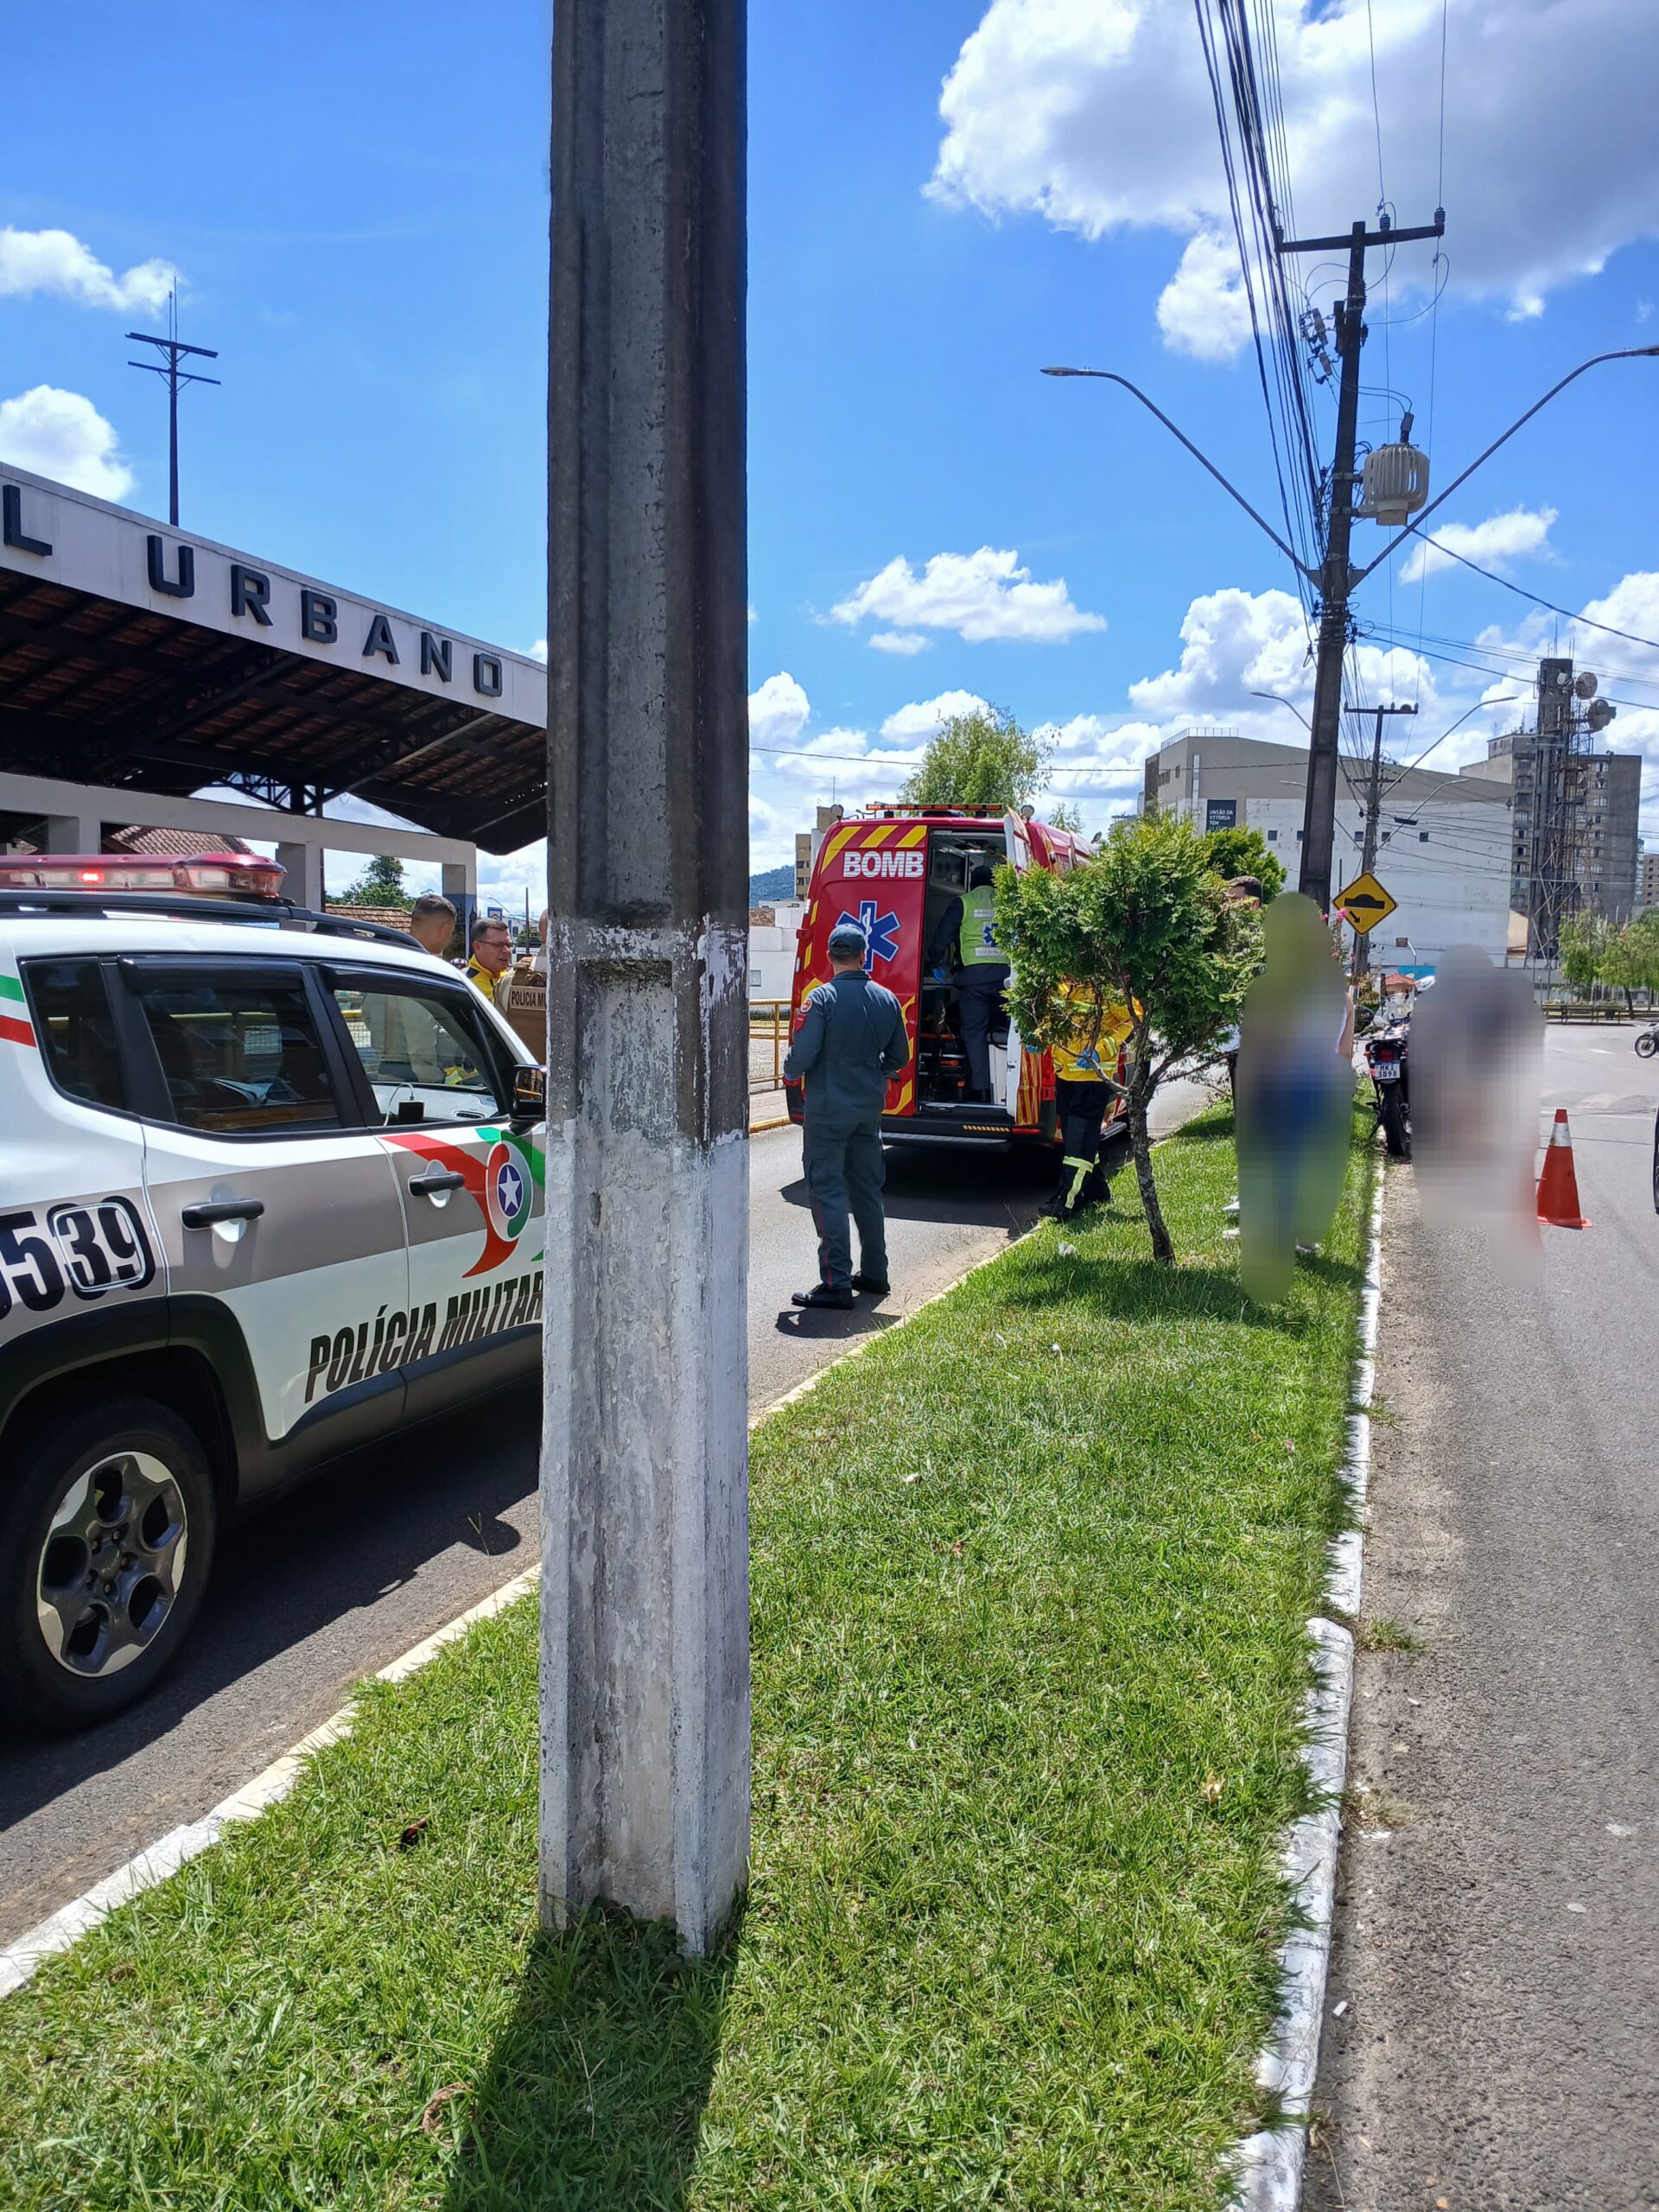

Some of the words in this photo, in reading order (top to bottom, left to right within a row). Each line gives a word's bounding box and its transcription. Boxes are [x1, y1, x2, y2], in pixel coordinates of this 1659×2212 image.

[147, 534, 503, 697] URBANO
[843, 850, 924, 878] BOMB
[0, 1196, 156, 1320] 539
[305, 1302, 436, 1404] POLÍCIA
[436, 1270, 544, 1353] MILITAR
